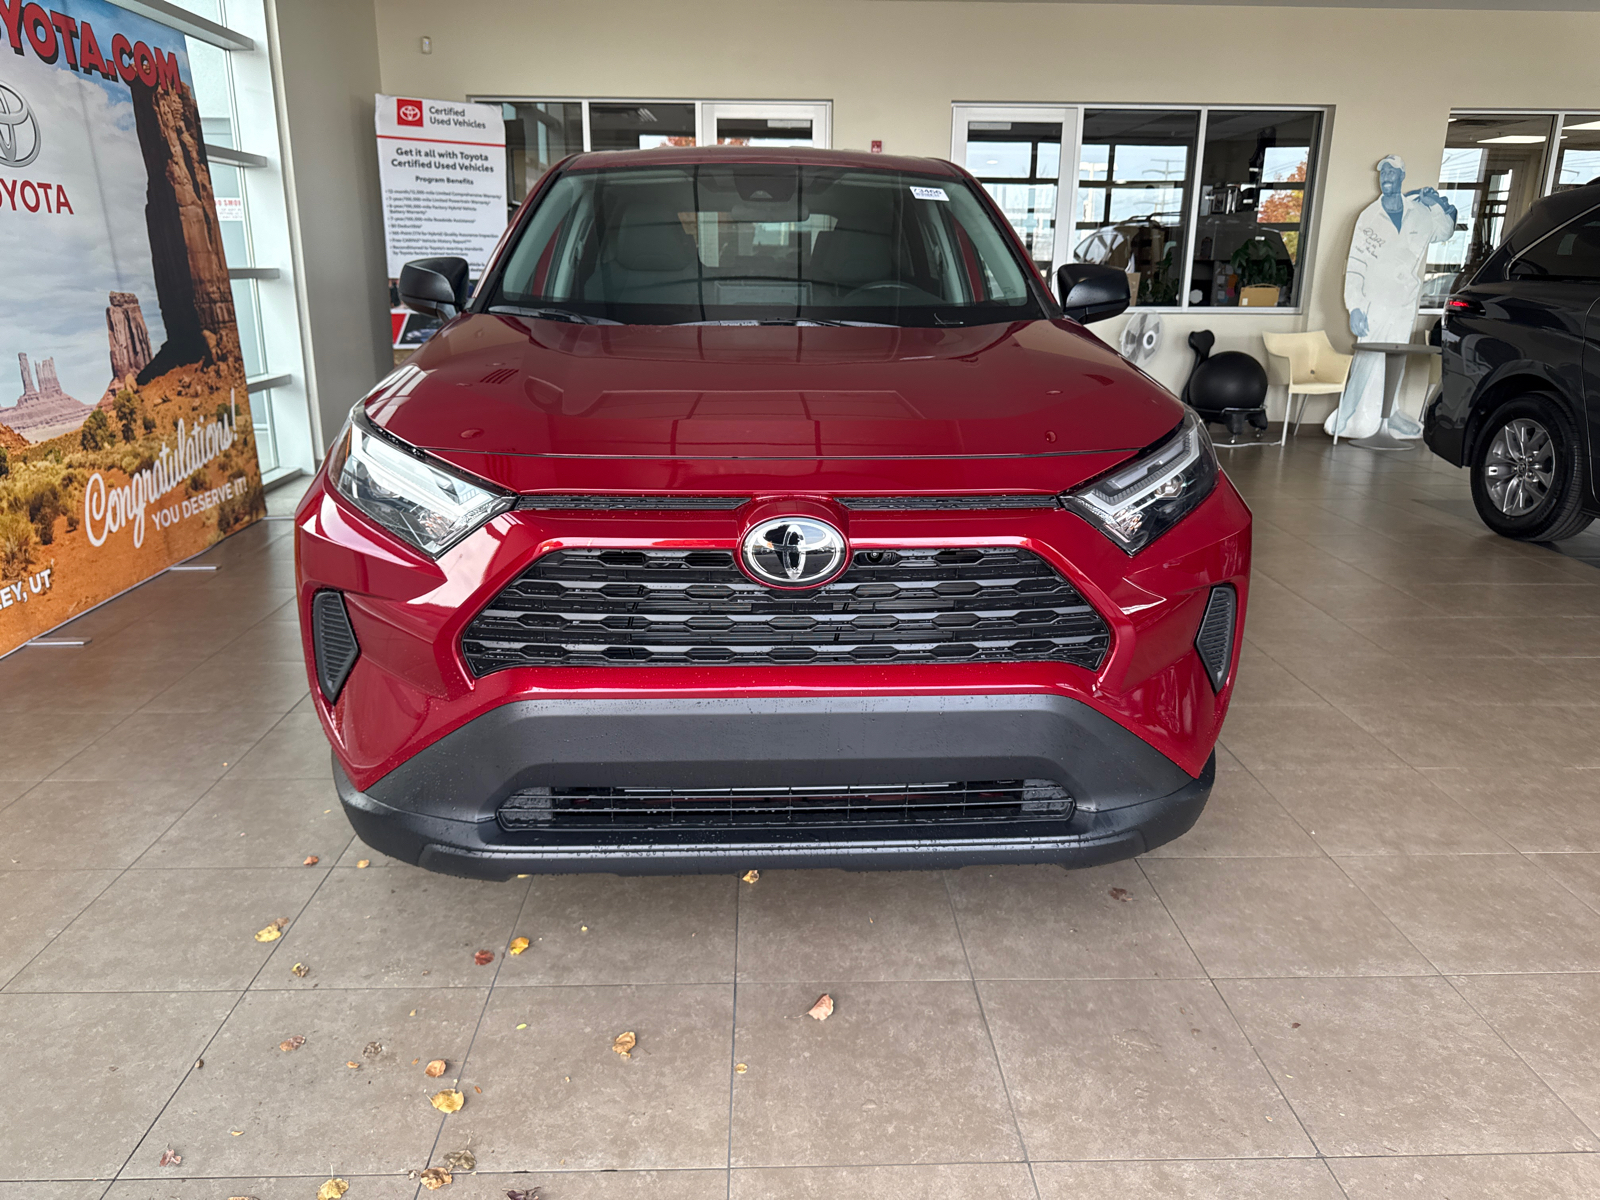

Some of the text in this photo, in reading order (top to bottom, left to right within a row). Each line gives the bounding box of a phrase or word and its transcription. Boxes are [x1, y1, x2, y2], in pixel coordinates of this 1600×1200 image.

[0, 0, 182, 94] YOTA.COM
[428, 106, 466, 117] Certified
[430, 116, 486, 129] Used Vehicles
[396, 147, 489, 162] Get it all with Toyota
[391, 158, 494, 173] Certified Used Vehicles
[415, 176, 474, 186] Program Benefits
[0, 178, 74, 214] YOTA
[85, 388, 238, 548] Congratulations!
[152, 476, 248, 532] YOU DESERVE IT!
[28, 568, 51, 594] UT
